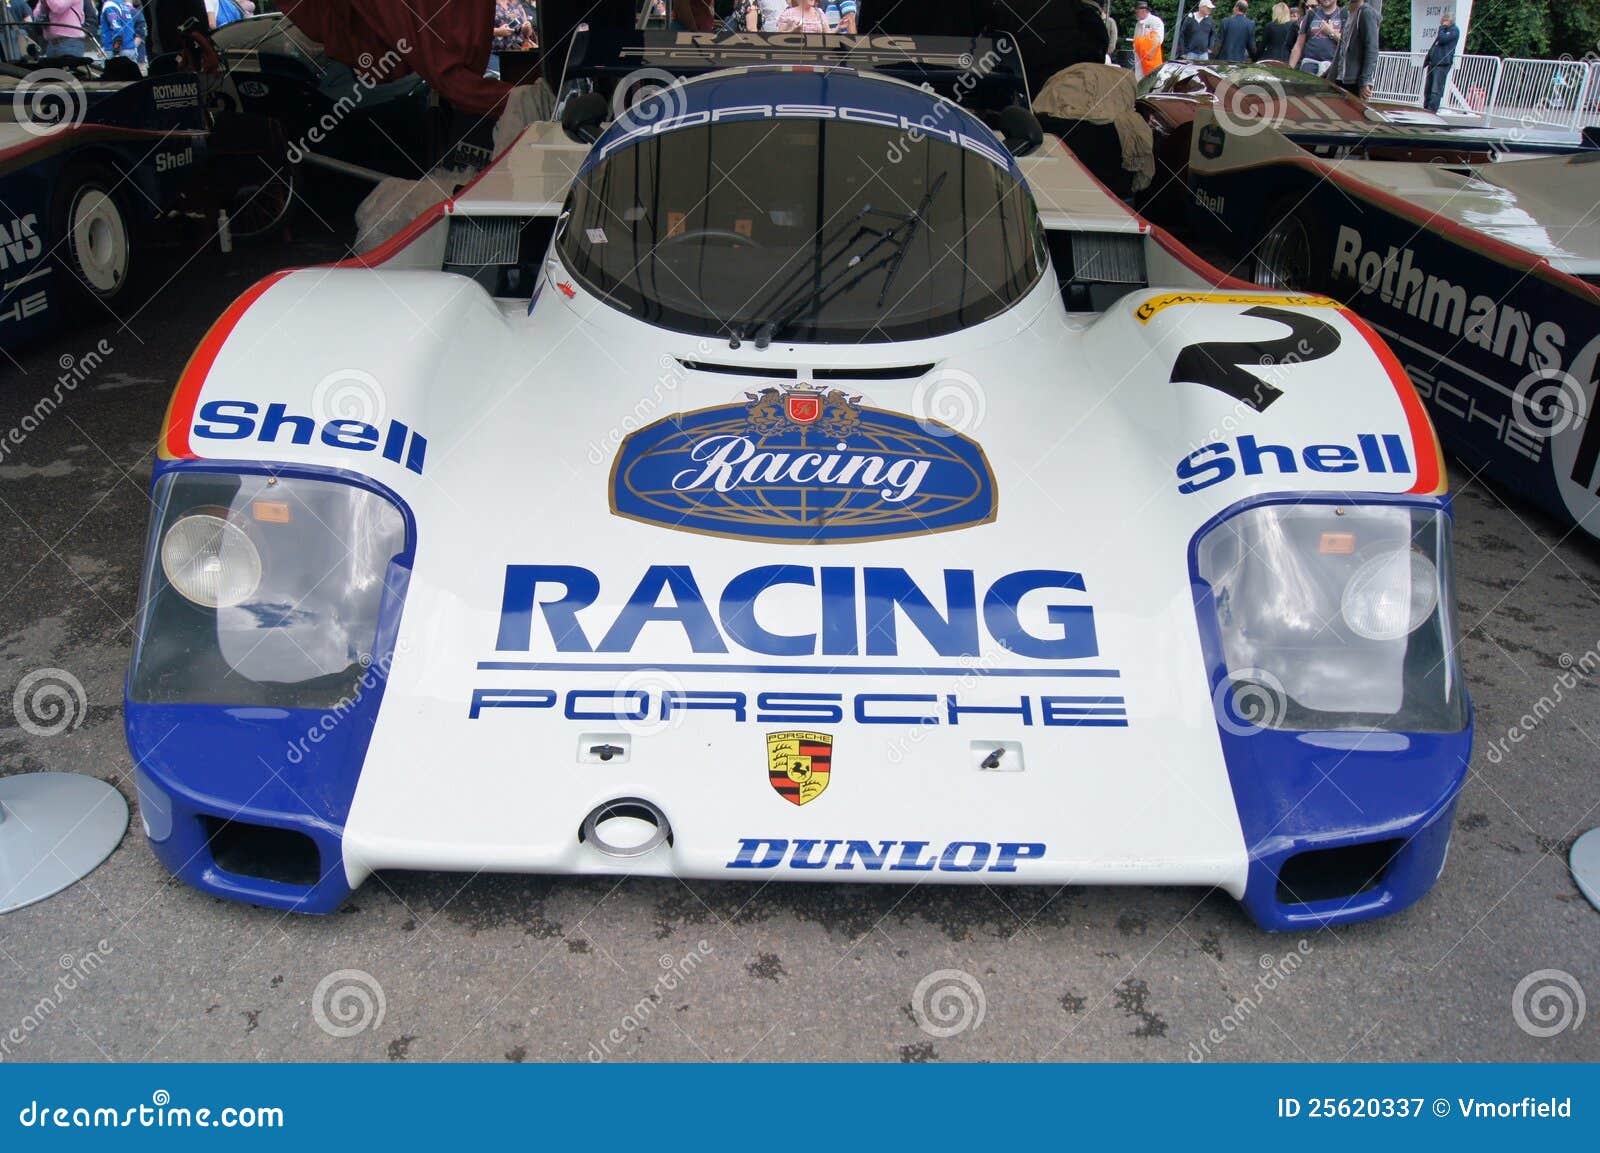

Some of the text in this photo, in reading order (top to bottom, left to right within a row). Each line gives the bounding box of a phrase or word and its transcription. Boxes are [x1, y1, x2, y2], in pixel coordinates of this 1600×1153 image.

[676, 33, 917, 50] RACING
[153, 82, 198, 100] ROTHMANS
[155, 147, 193, 172] Shell
[600, 104, 1010, 172] PORSCHE
[1195, 188, 1225, 215] Shell
[1332, 224, 1567, 379] Rothmans
[1169, 306, 1342, 413] 2
[193, 400, 428, 475] Shell
[671, 435, 931, 502] Racing
[1175, 433, 1412, 494] Shell
[494, 564, 1100, 660] RACING
[468, 688, 1129, 728] PORSCHE
[769, 733, 831, 743] PORSCHE
[726, 838, 1048, 874] DUNLOP
